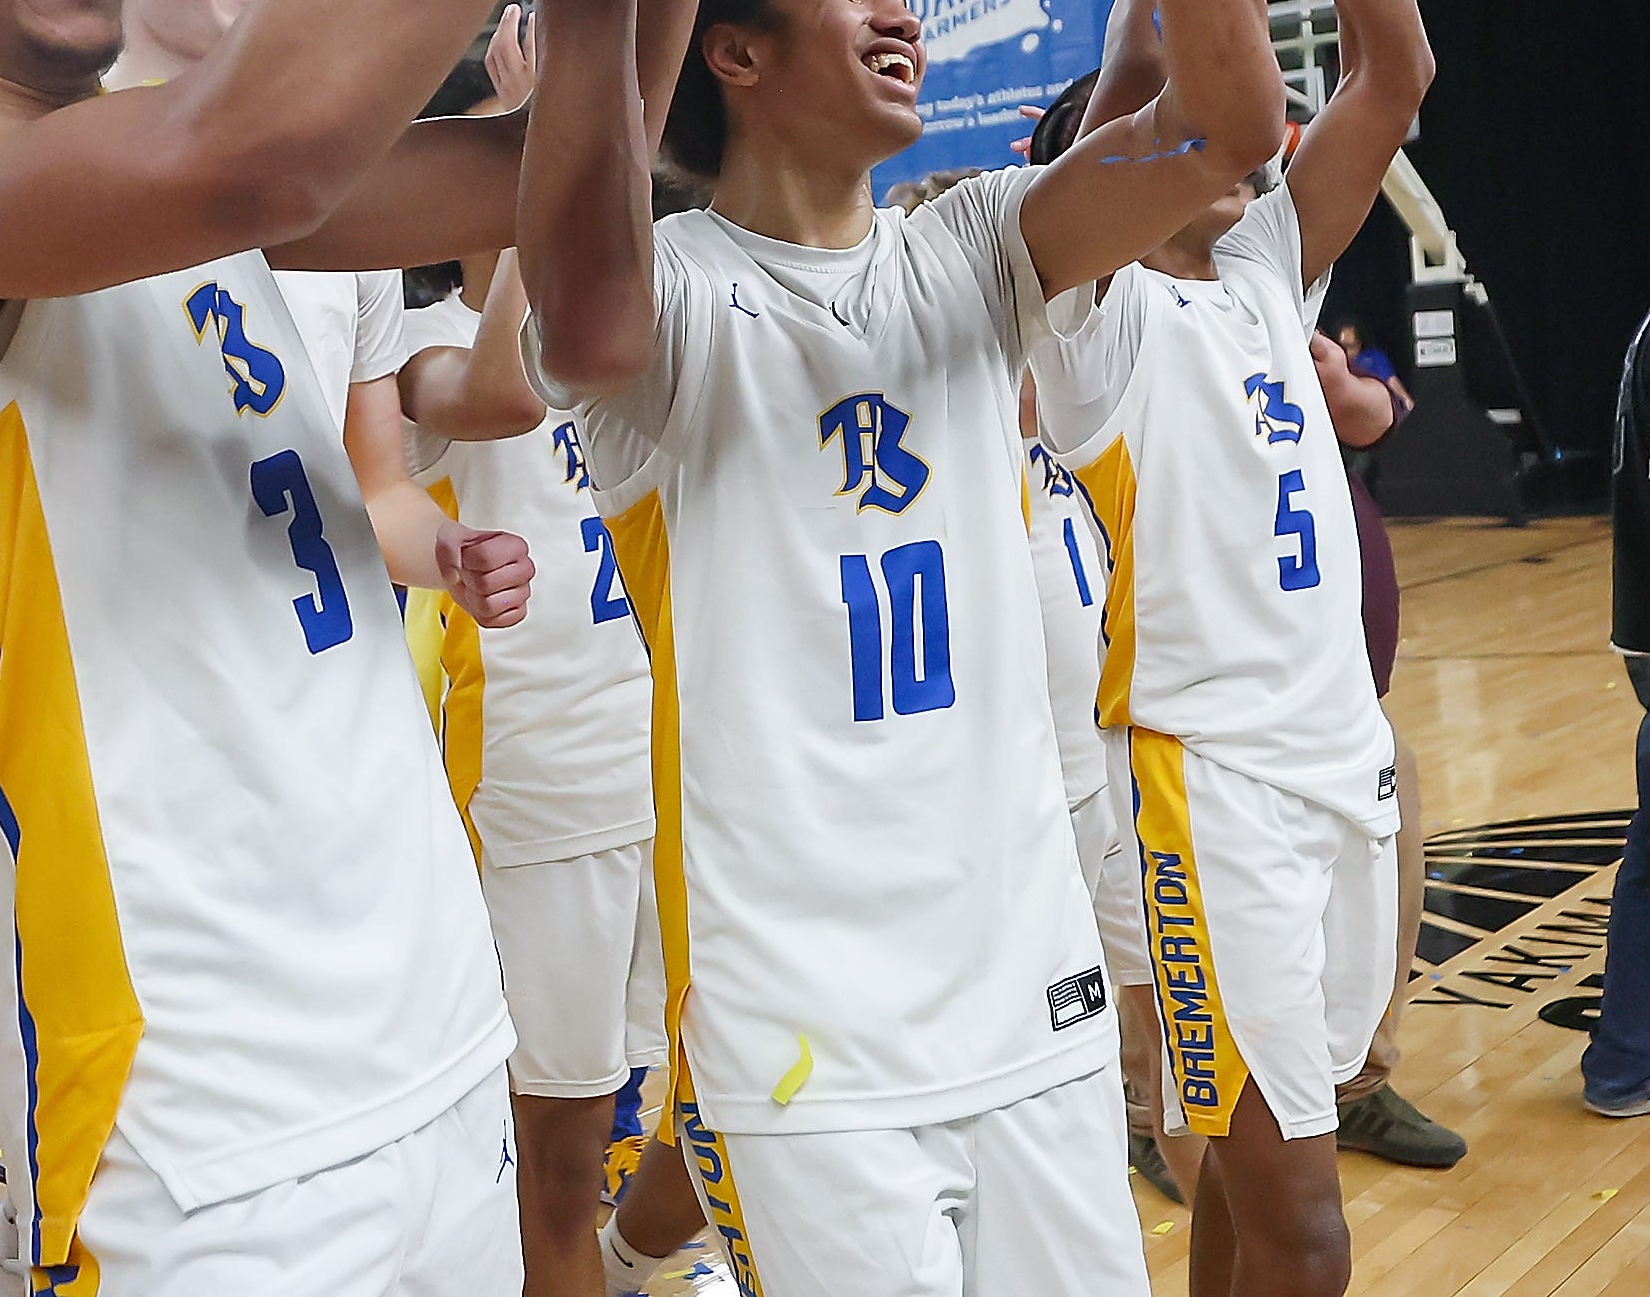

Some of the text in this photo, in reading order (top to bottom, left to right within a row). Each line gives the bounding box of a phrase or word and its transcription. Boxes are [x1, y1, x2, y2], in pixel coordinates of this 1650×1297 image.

[250, 448, 354, 656] 3
[1273, 469, 1322, 592] 5
[839, 539, 957, 723] 10
[1087, 981, 1102, 1002] M
[1148, 850, 1219, 1108] BREMERTON
